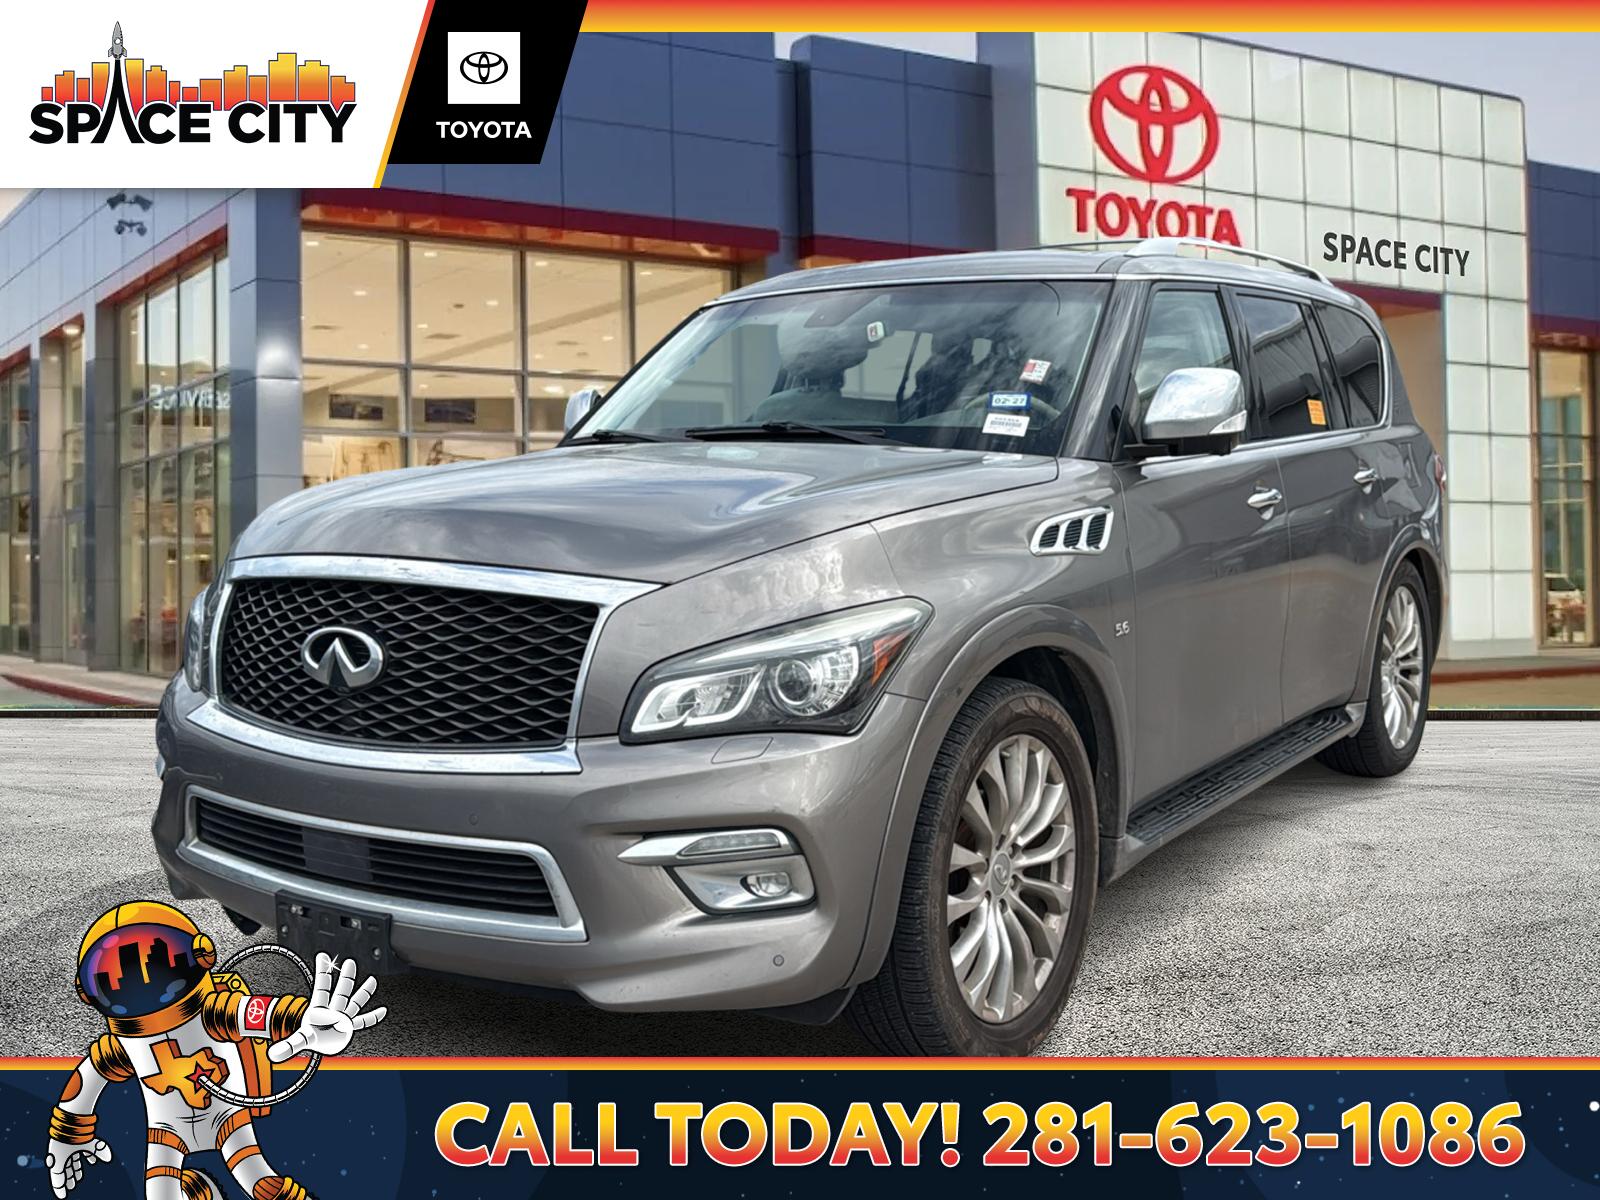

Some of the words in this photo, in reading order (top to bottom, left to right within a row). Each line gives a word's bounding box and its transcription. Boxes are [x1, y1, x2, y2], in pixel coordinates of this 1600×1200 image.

[1066, 188, 1242, 247] TOYOTA
[1323, 232, 1407, 270] SPACE
[1415, 244, 1470, 276] CITY
